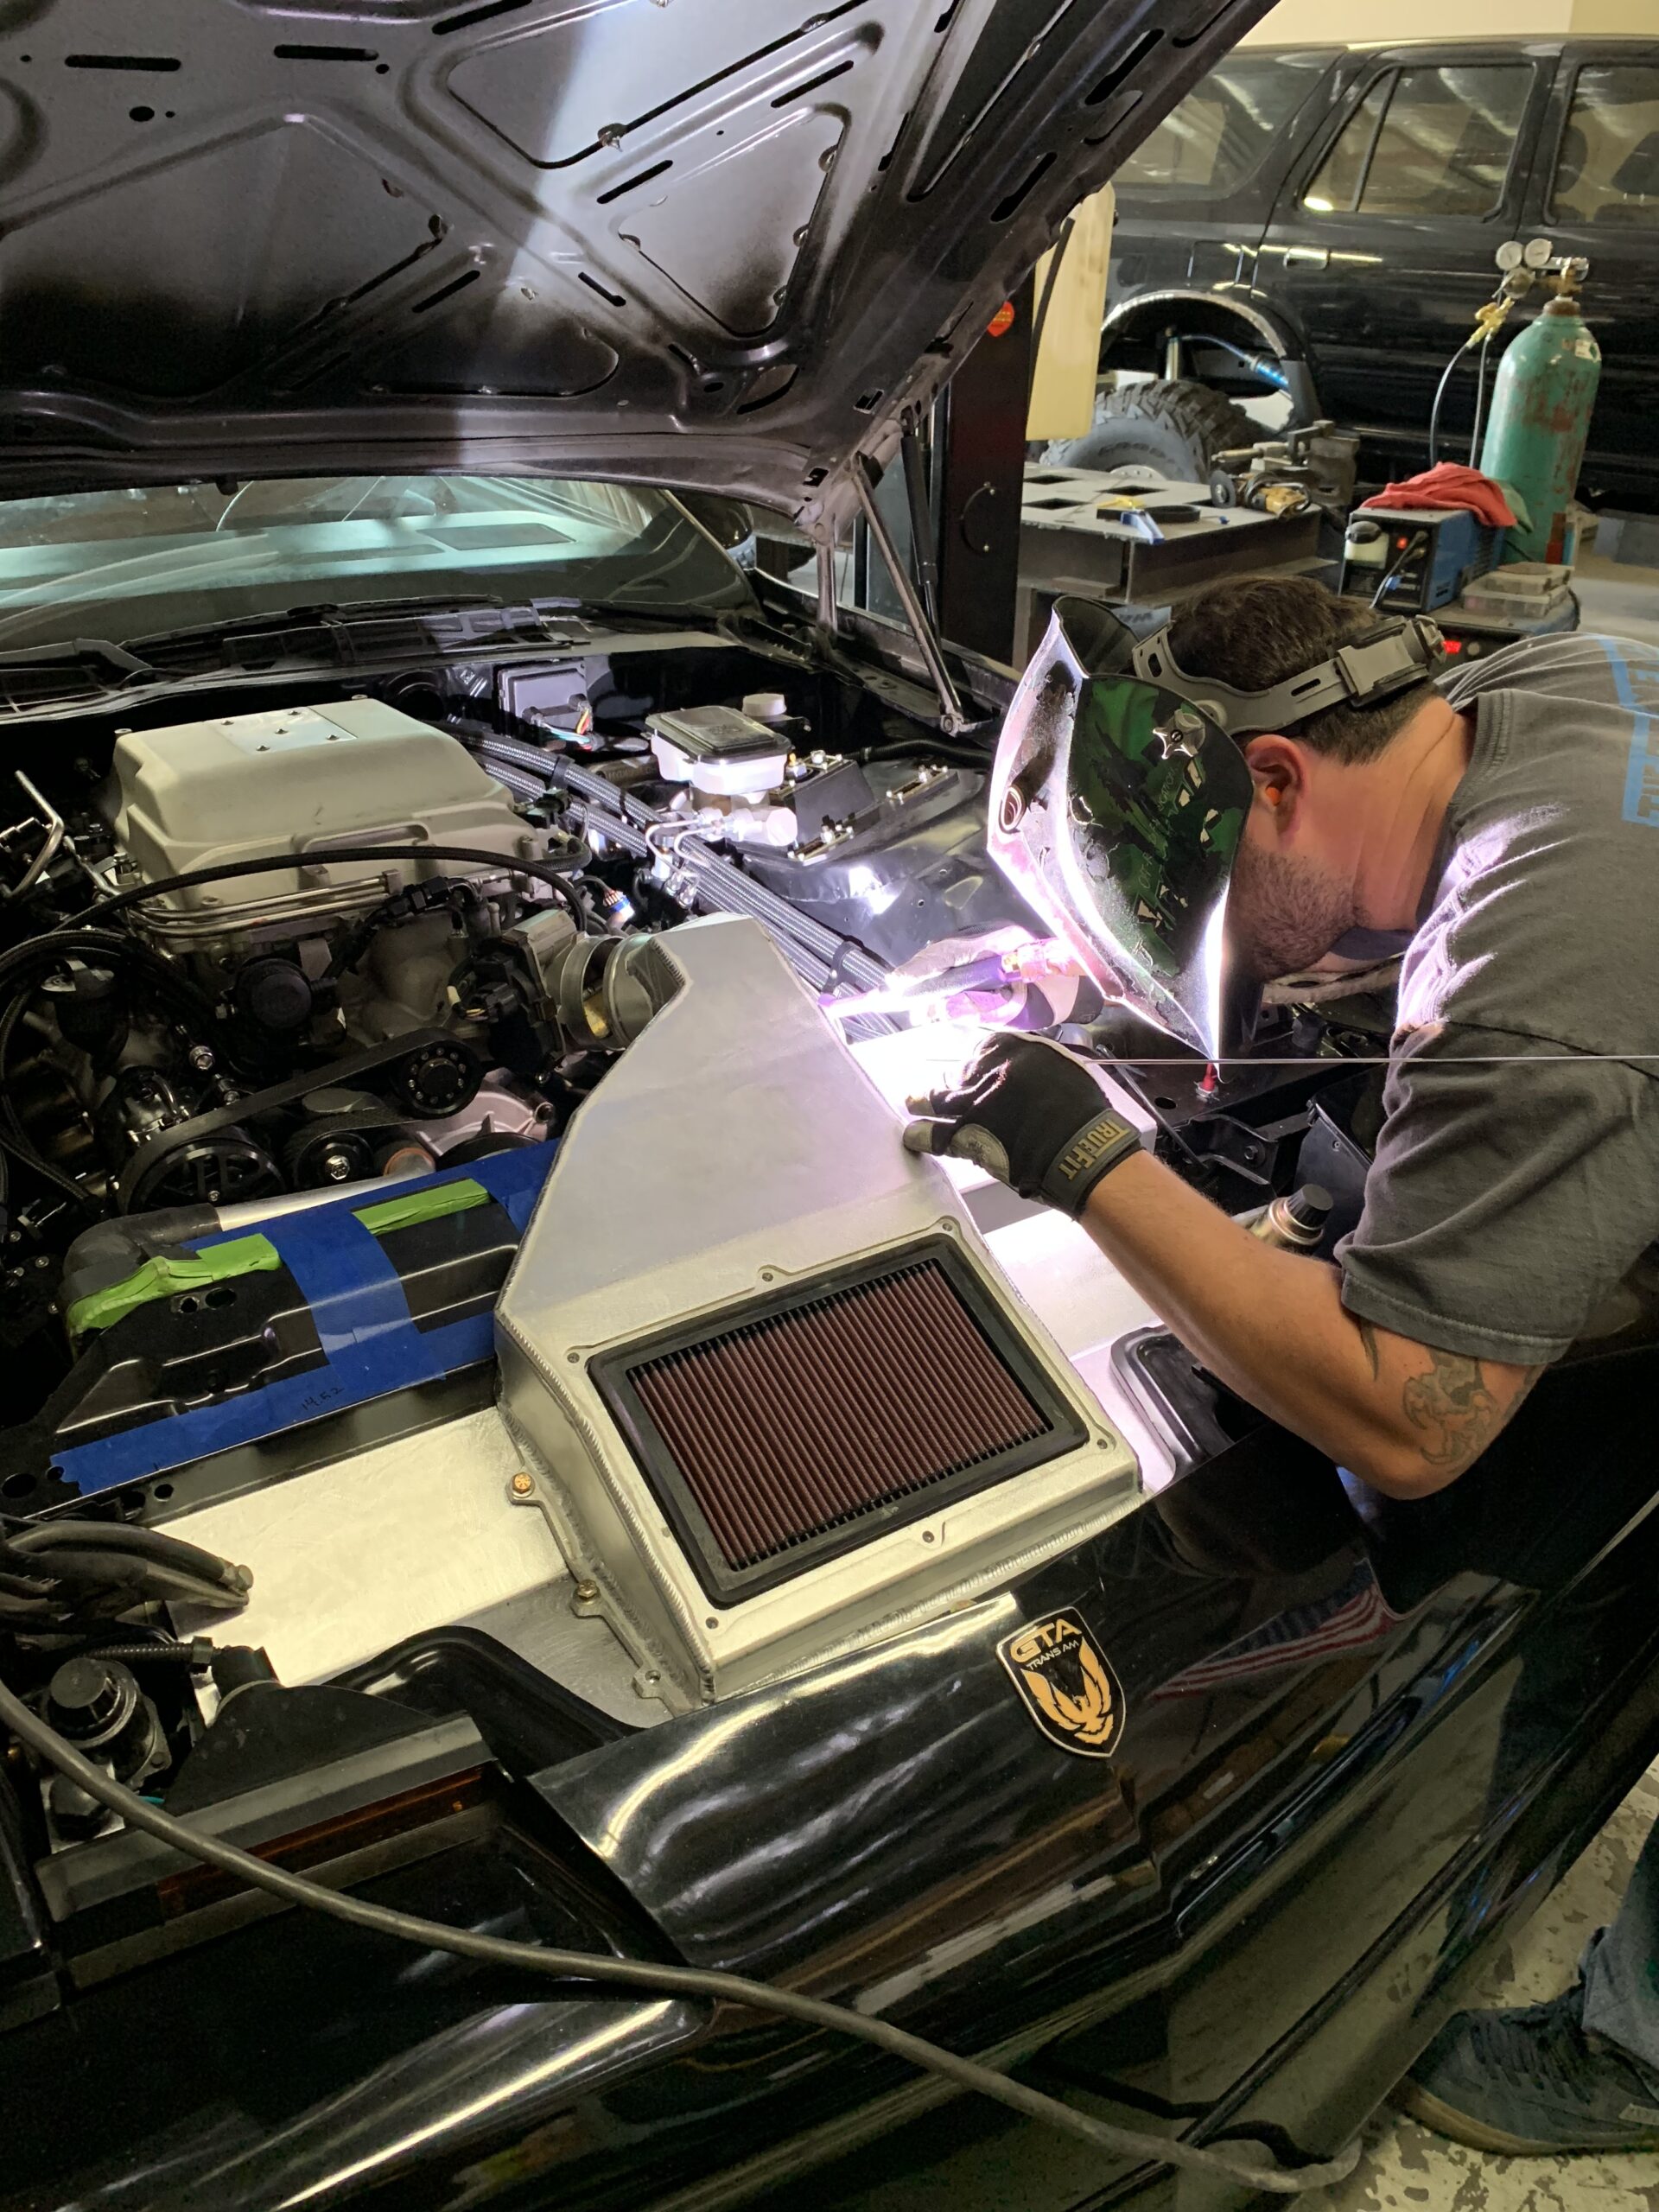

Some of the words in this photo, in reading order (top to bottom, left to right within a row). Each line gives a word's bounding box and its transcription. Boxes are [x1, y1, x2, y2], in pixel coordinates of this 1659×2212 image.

[1058, 1118, 1130, 1181] TRUEFIT
[1010, 1618, 1082, 1663] GTA
[1026, 1648, 1062, 1671] TRANS
[1063, 1640, 1079, 1653] AM
